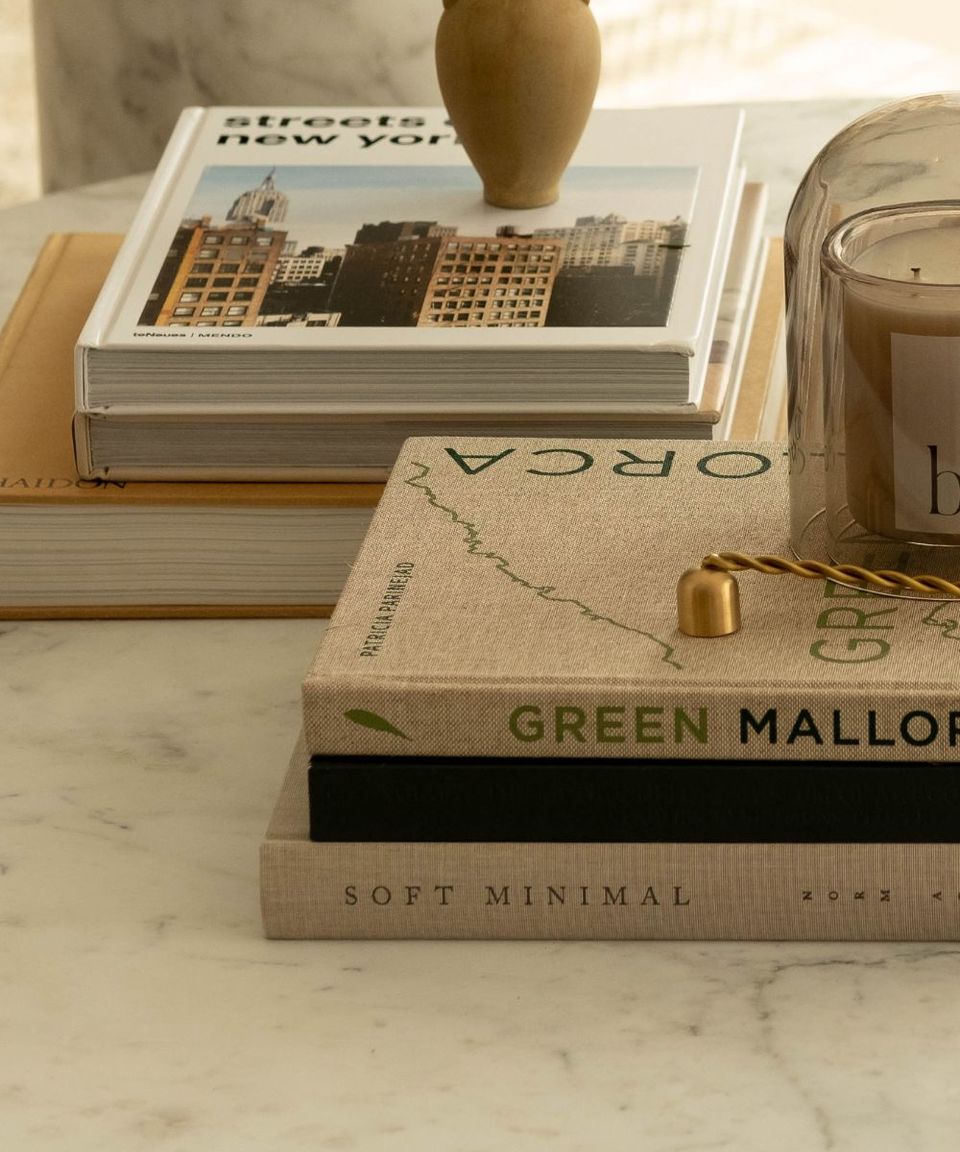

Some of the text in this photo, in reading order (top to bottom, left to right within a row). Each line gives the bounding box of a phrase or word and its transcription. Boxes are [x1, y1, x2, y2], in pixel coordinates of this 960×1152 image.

[223, 116, 426, 129] streets
[216, 134, 339, 146] new
[443, 447, 785, 479] ORCA
[359, 614, 395, 657] PATRICIA
[508, 704, 708, 744] GREEN
[344, 885, 691, 906] SOFT MINIMAL
[802, 889, 890, 902] NORM
